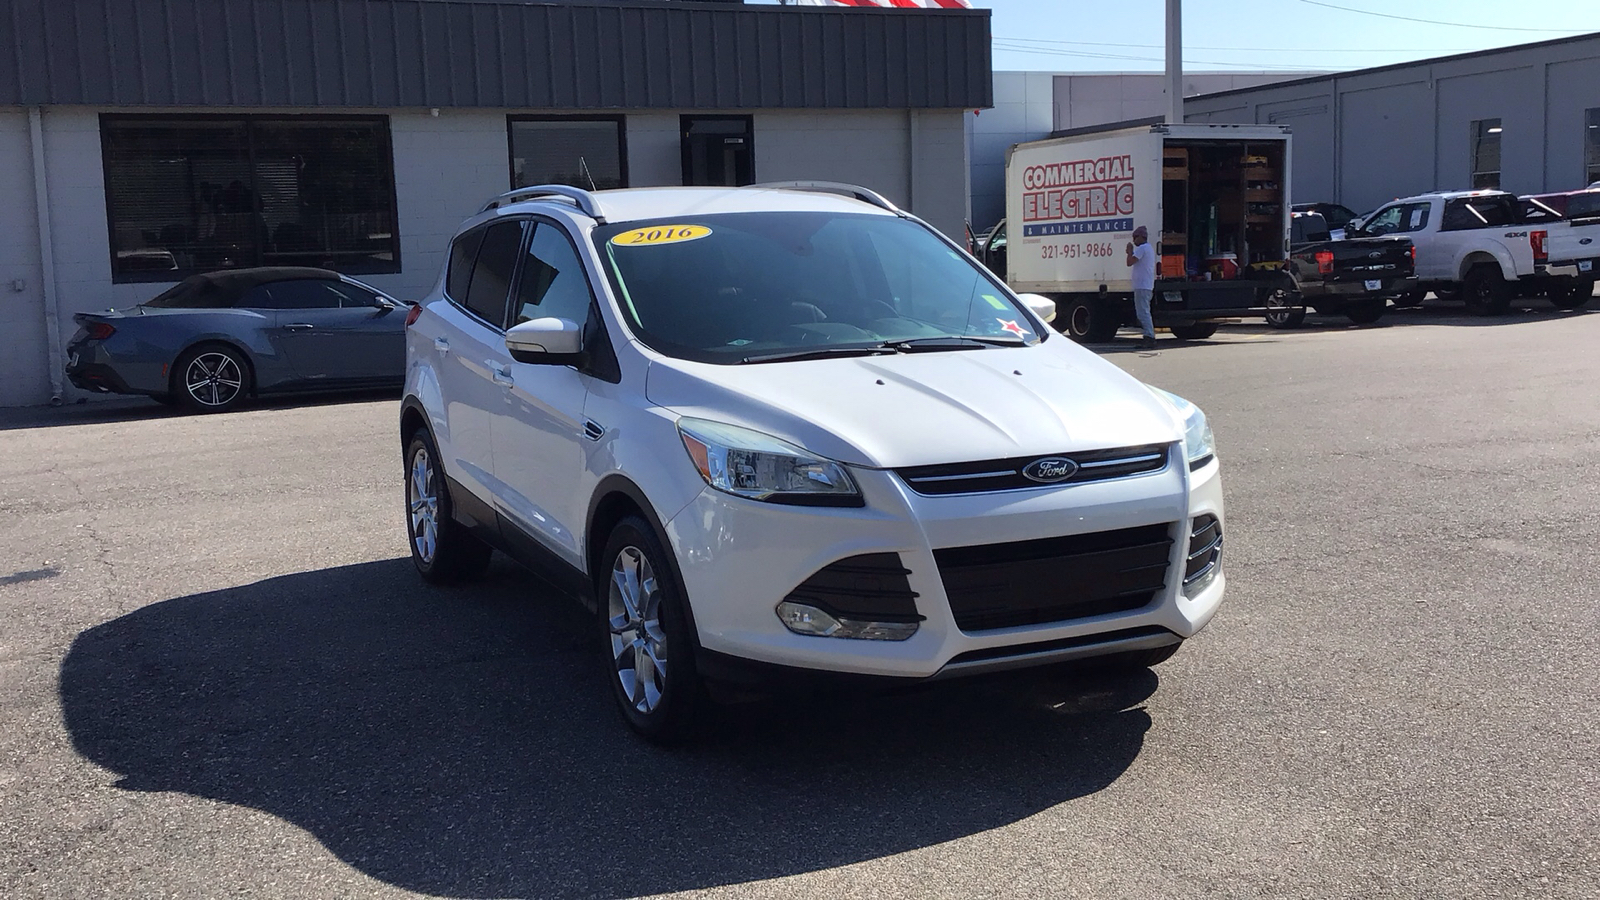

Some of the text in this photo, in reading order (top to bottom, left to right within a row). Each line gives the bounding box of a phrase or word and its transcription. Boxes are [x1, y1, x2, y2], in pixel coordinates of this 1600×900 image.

[1023, 155, 1134, 190] COMMERCIAL
[1023, 183, 1134, 222] ELECTRIC
[631, 227, 692, 244] 2016
[1028, 221, 1127, 235] & MAINTENANCE
[1041, 243, 1113, 259] 321-951-9866
[1038, 461, 1067, 477] Ford
